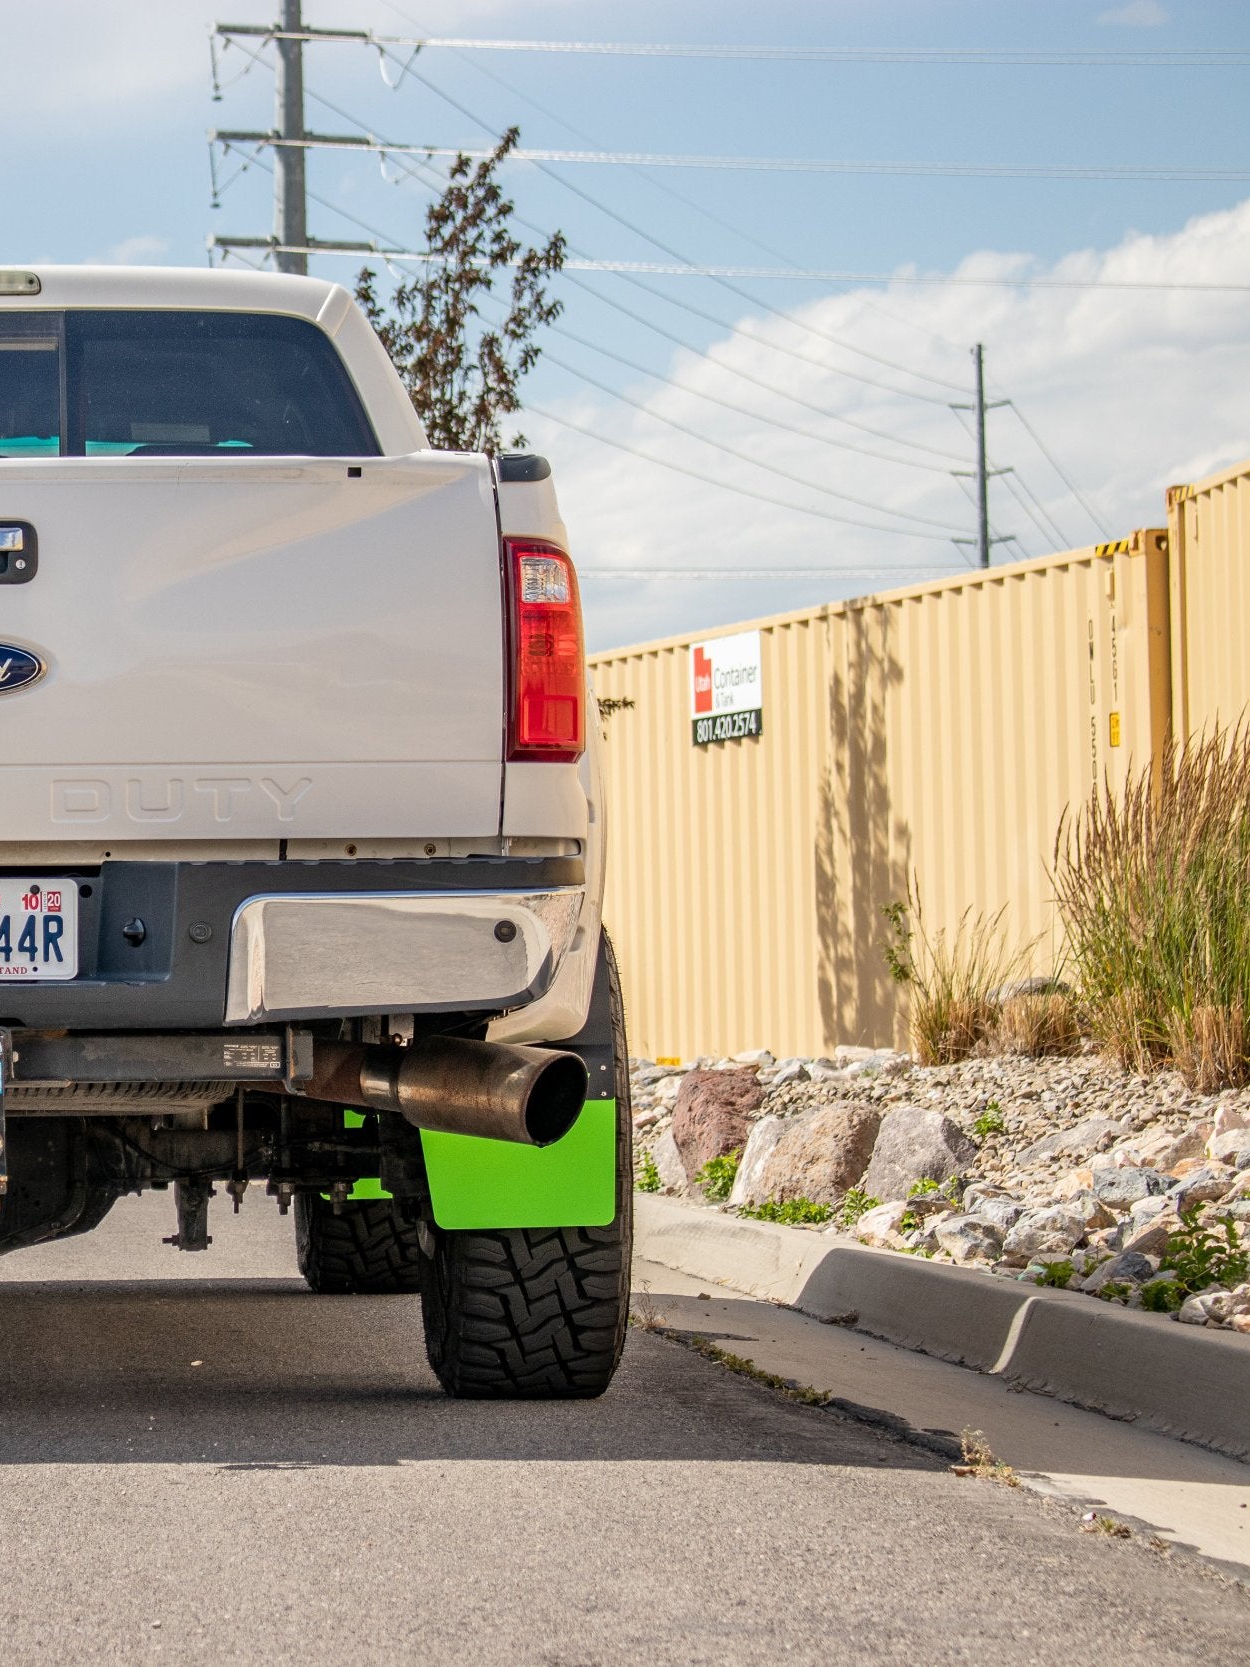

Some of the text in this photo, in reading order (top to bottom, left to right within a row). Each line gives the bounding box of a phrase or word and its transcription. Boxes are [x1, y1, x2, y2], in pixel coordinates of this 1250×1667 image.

[694, 674, 711, 693] Utah
[713, 665, 757, 689] Container
[696, 711, 757, 743] 801.420.2574
[49, 777, 314, 823] DUTY
[22, 894, 39, 910] 10
[47, 893, 61, 907] 20
